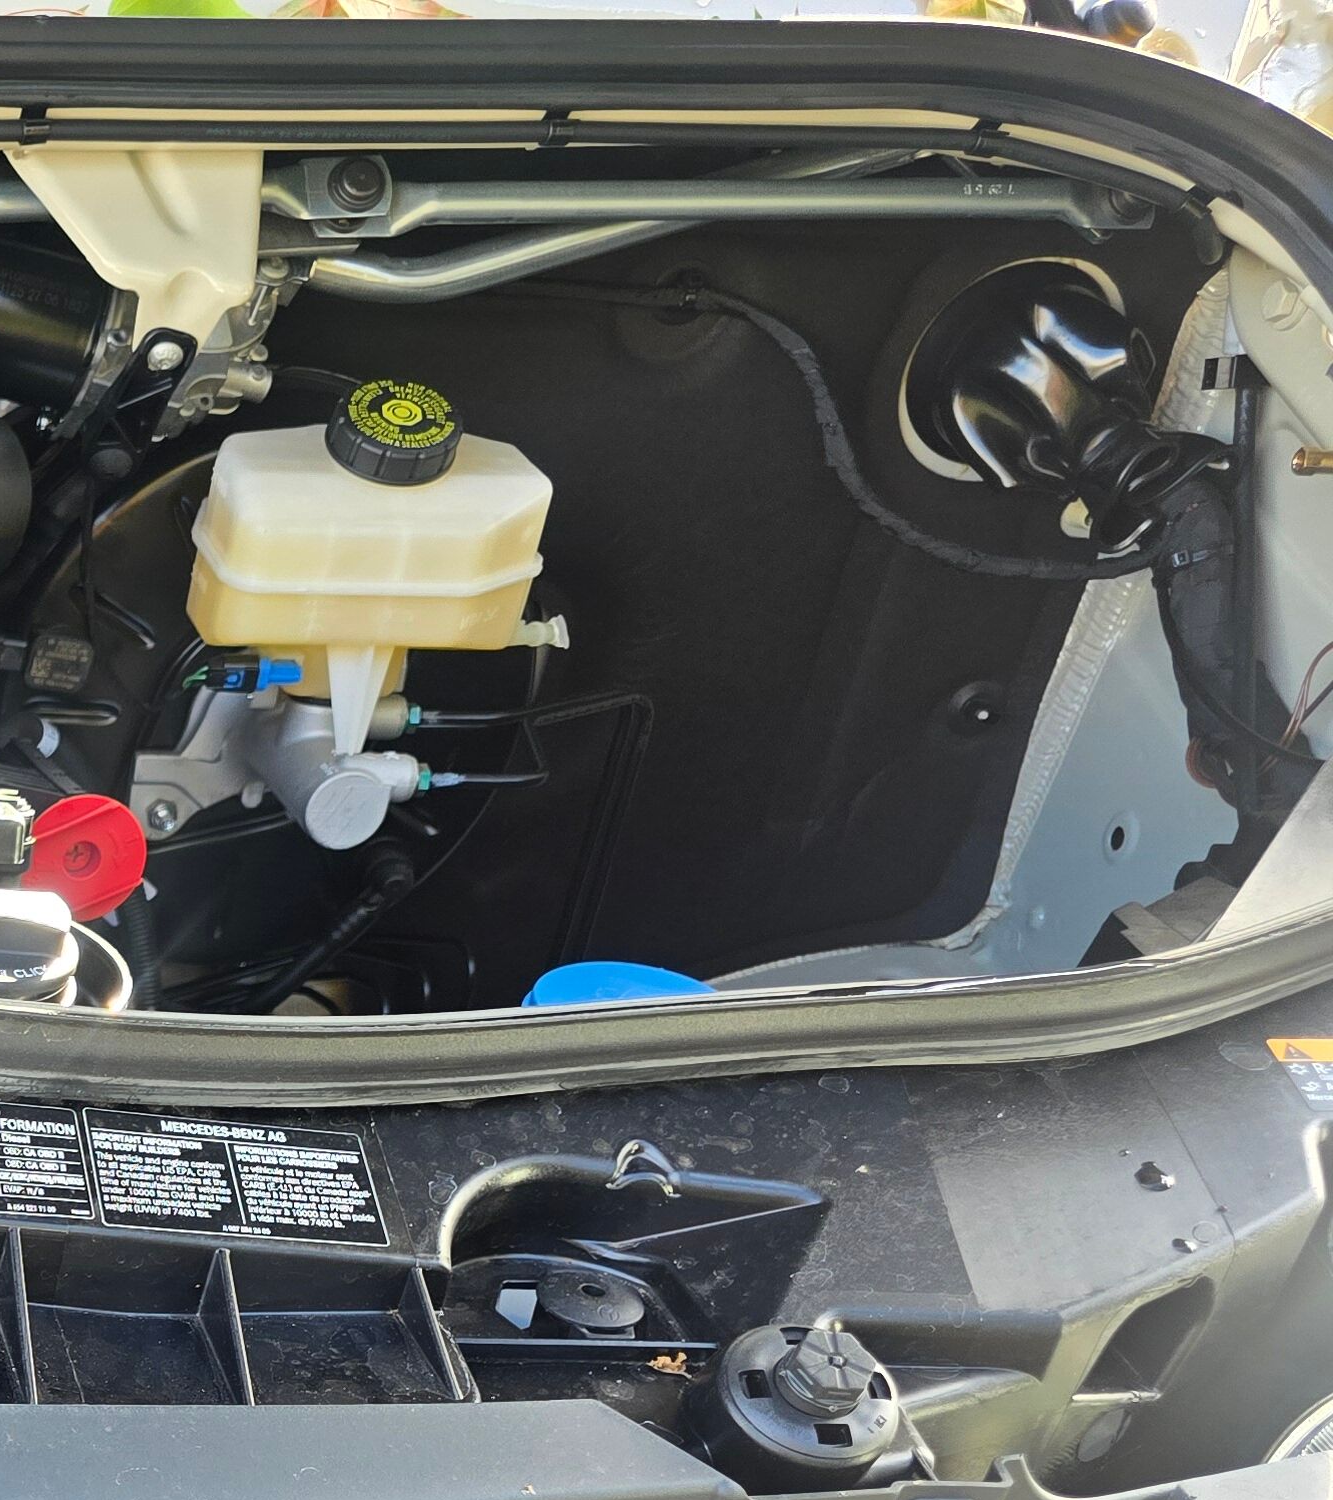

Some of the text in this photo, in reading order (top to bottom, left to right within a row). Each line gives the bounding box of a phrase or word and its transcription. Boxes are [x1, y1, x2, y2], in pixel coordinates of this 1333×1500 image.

[92, 1132, 141, 1144] IMPORTANT
[160, 1120, 287, 1142] MERCEDES-BENZ AG
[1, 1133, 31, 1144] Diesel
[95, 1151, 113, 1160] This
[114, 1154, 143, 1163] vehicle
[145, 1156, 160, 1164] and
[191, 1161, 225, 1170] conform
[119, 1162, 161, 1173] applicable
[162, 1165, 174, 1174] US
[99, 1169, 114, 1177] and
[116, 1170, 154, 1180] Canadian
[155, 1175, 201, 1185] regulations
[100, 1177, 119, 1186] time
[131, 1180, 182, 1190] manufacture
[197, 1185, 232, 1195] vehicles
[317, 1187, 348, 1197] Canada
[101, 1186, 126, 1194] under
[129, 1188, 155, 1197] 10000
[199, 1193, 214, 1202] and
[104, 1203, 133, 1213] weight
[173, 1208, 195, 1217] 7400
[111, 1196, 151, 1205] maximum
[153, 1199, 191, 1208] unloaded
[192, 1201, 221, 1211] vehicle
[292, 1209, 319, 1218] 10000
[352, 1214, 375, 1223] poids
[310, 1219, 333, 1227] 7400
